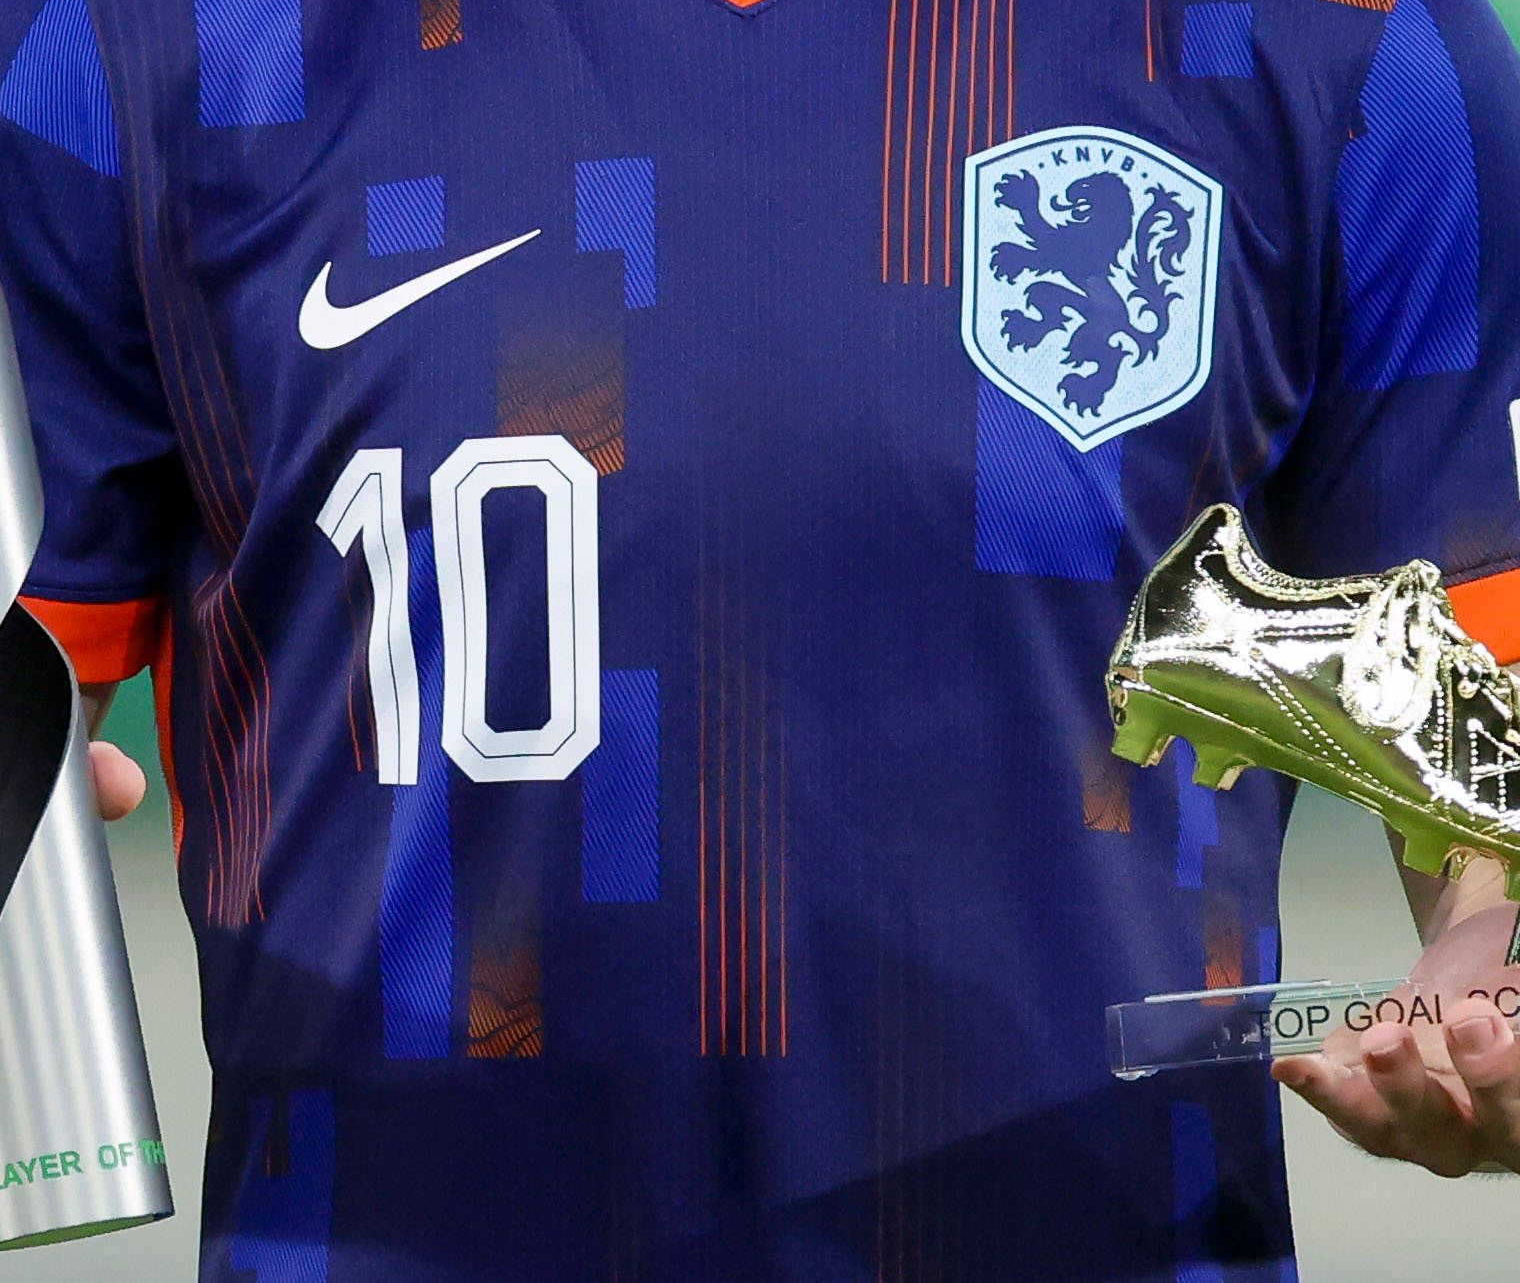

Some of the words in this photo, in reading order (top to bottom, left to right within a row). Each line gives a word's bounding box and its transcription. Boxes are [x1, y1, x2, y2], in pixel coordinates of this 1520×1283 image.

[1050, 146, 1135, 172] KNVB
[315, 434, 601, 785] 10
[97, 1142, 134, 1171] OF
